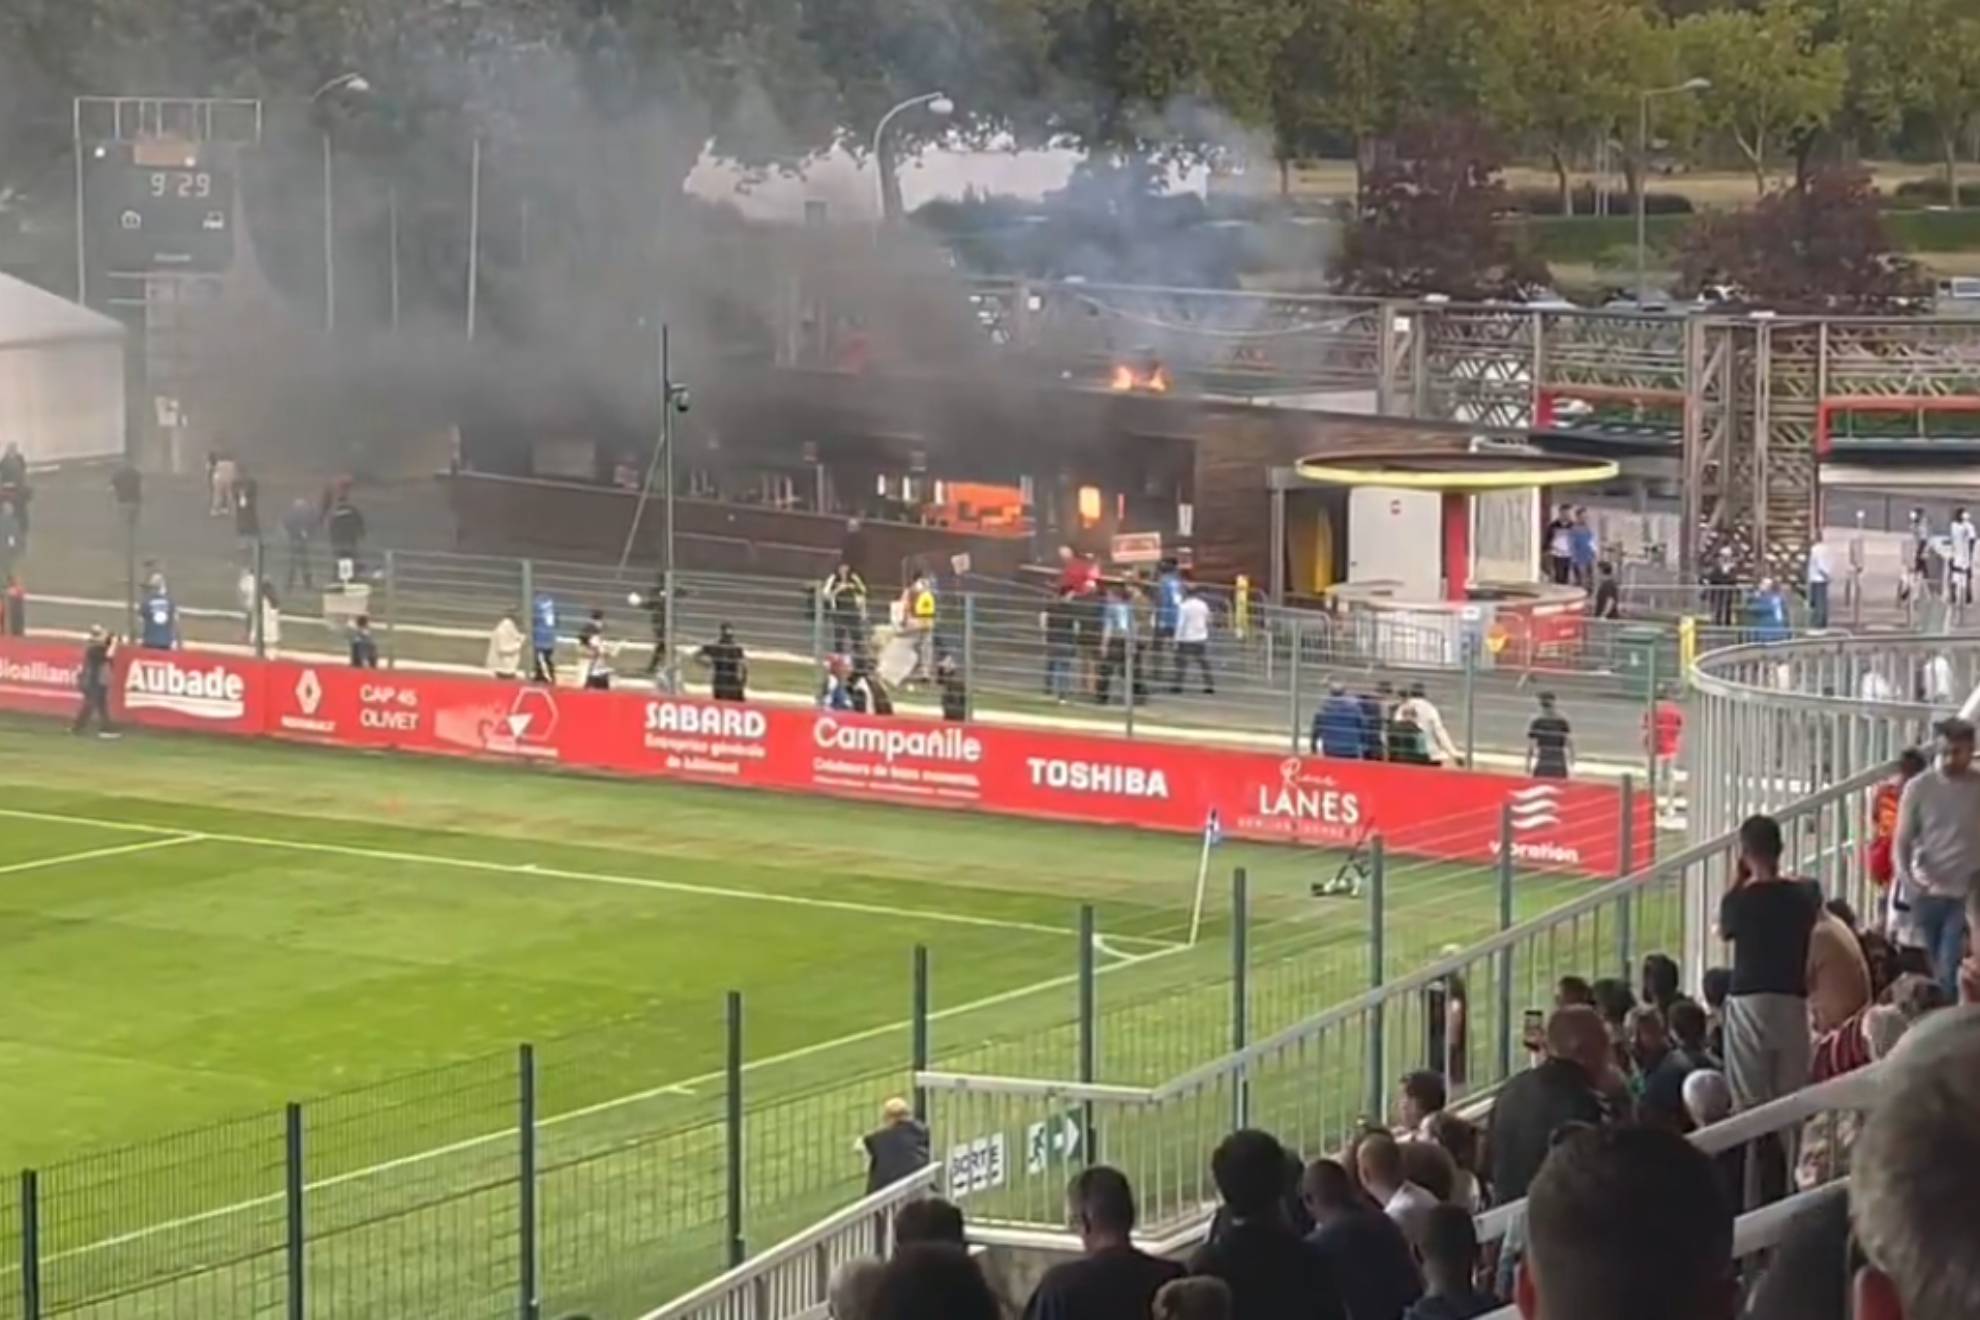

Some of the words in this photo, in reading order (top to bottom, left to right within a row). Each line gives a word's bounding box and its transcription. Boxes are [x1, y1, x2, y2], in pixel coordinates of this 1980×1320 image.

[125, 659, 245, 700] Aubade
[359, 684, 395, 704] CAP
[359, 709, 419, 730] OLIVET
[645, 702, 767, 738] SABARD
[1026, 757, 1169, 798] TOSHIBA
[1259, 784, 1360, 825] LANES
